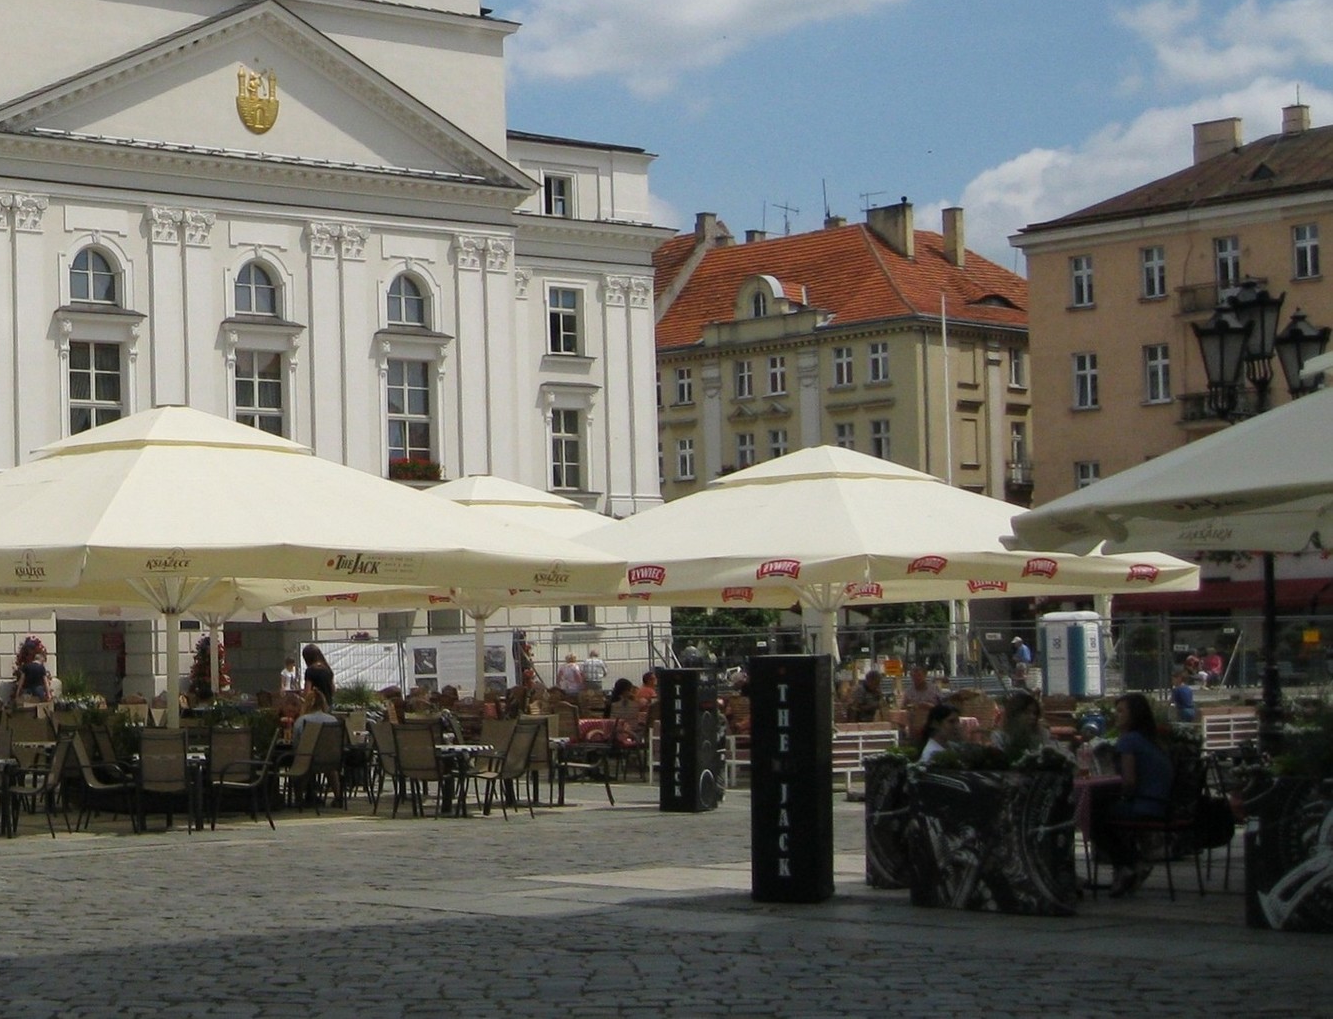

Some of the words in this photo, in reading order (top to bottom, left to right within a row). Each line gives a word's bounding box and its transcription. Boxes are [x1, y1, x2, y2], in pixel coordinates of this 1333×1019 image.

[777, 684, 790, 752] THE
[674, 742, 682, 797] JACK
[778, 783, 791, 877] JACK
